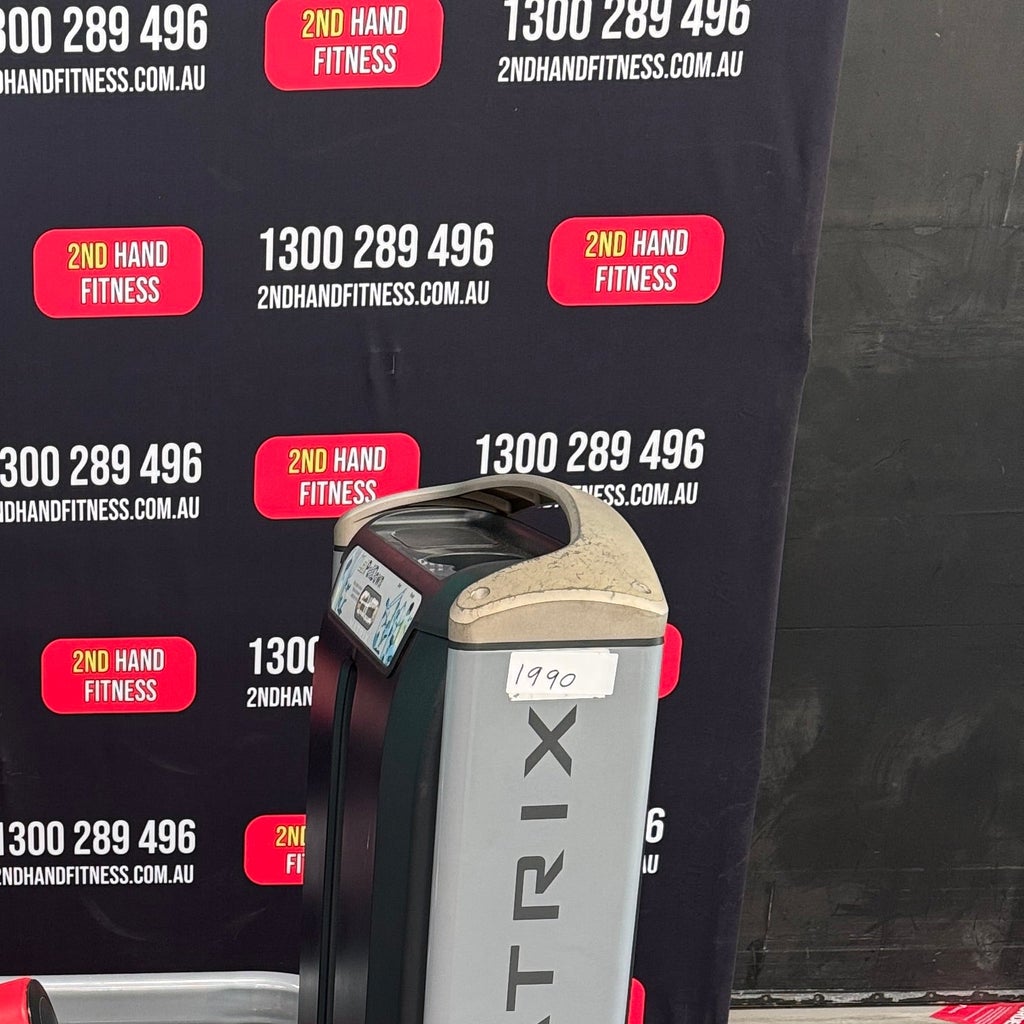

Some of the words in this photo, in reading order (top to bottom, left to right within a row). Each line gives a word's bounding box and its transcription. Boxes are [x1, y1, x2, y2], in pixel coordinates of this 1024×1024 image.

[62, 5, 130, 53] 289
[139, 2, 208, 51] 496
[302, 8, 344, 38] 2ND
[350, 5, 407, 36] HAND
[503, 0, 587, 42] 1300
[601, 0, 673, 40] 289
[680, 0, 751, 37] 496
[314, 44, 397, 75] FITNESS
[497, 50, 744, 83] 2NDHANDFITNESS.COM.AU
[68, 242, 108, 270] 2ND
[114, 240, 168, 268] HAND
[259, 225, 344, 272] 1300
[353, 223, 419, 269] 289
[427, 222, 495, 268] 496
[585, 230, 627, 258] 2ND
[632, 229, 689, 257] HAND
[81, 276, 160, 304] FITNESS
[595, 264, 678, 292] FITNESS
[257, 280, 490, 310] 2NDHANDFITNESS.COM.AU
[69, 443, 131, 486] 289
[139, 441, 202, 485] 496
[288, 448, 327, 474] 2ND
[333, 446, 387, 473] HAND
[475, 431, 558, 475] 1300
[566, 429, 632, 473] 289
[638, 427, 706, 470] 496
[299, 480, 377, 506] FITNESS
[73, 649, 109, 673] 2ND
[115, 648, 165, 672] HAND
[84, 678, 157, 702] FITNESS
[513, 662, 578, 690] 1990
[73, 819, 130, 855] 289
[138, 818, 196, 855] 496
